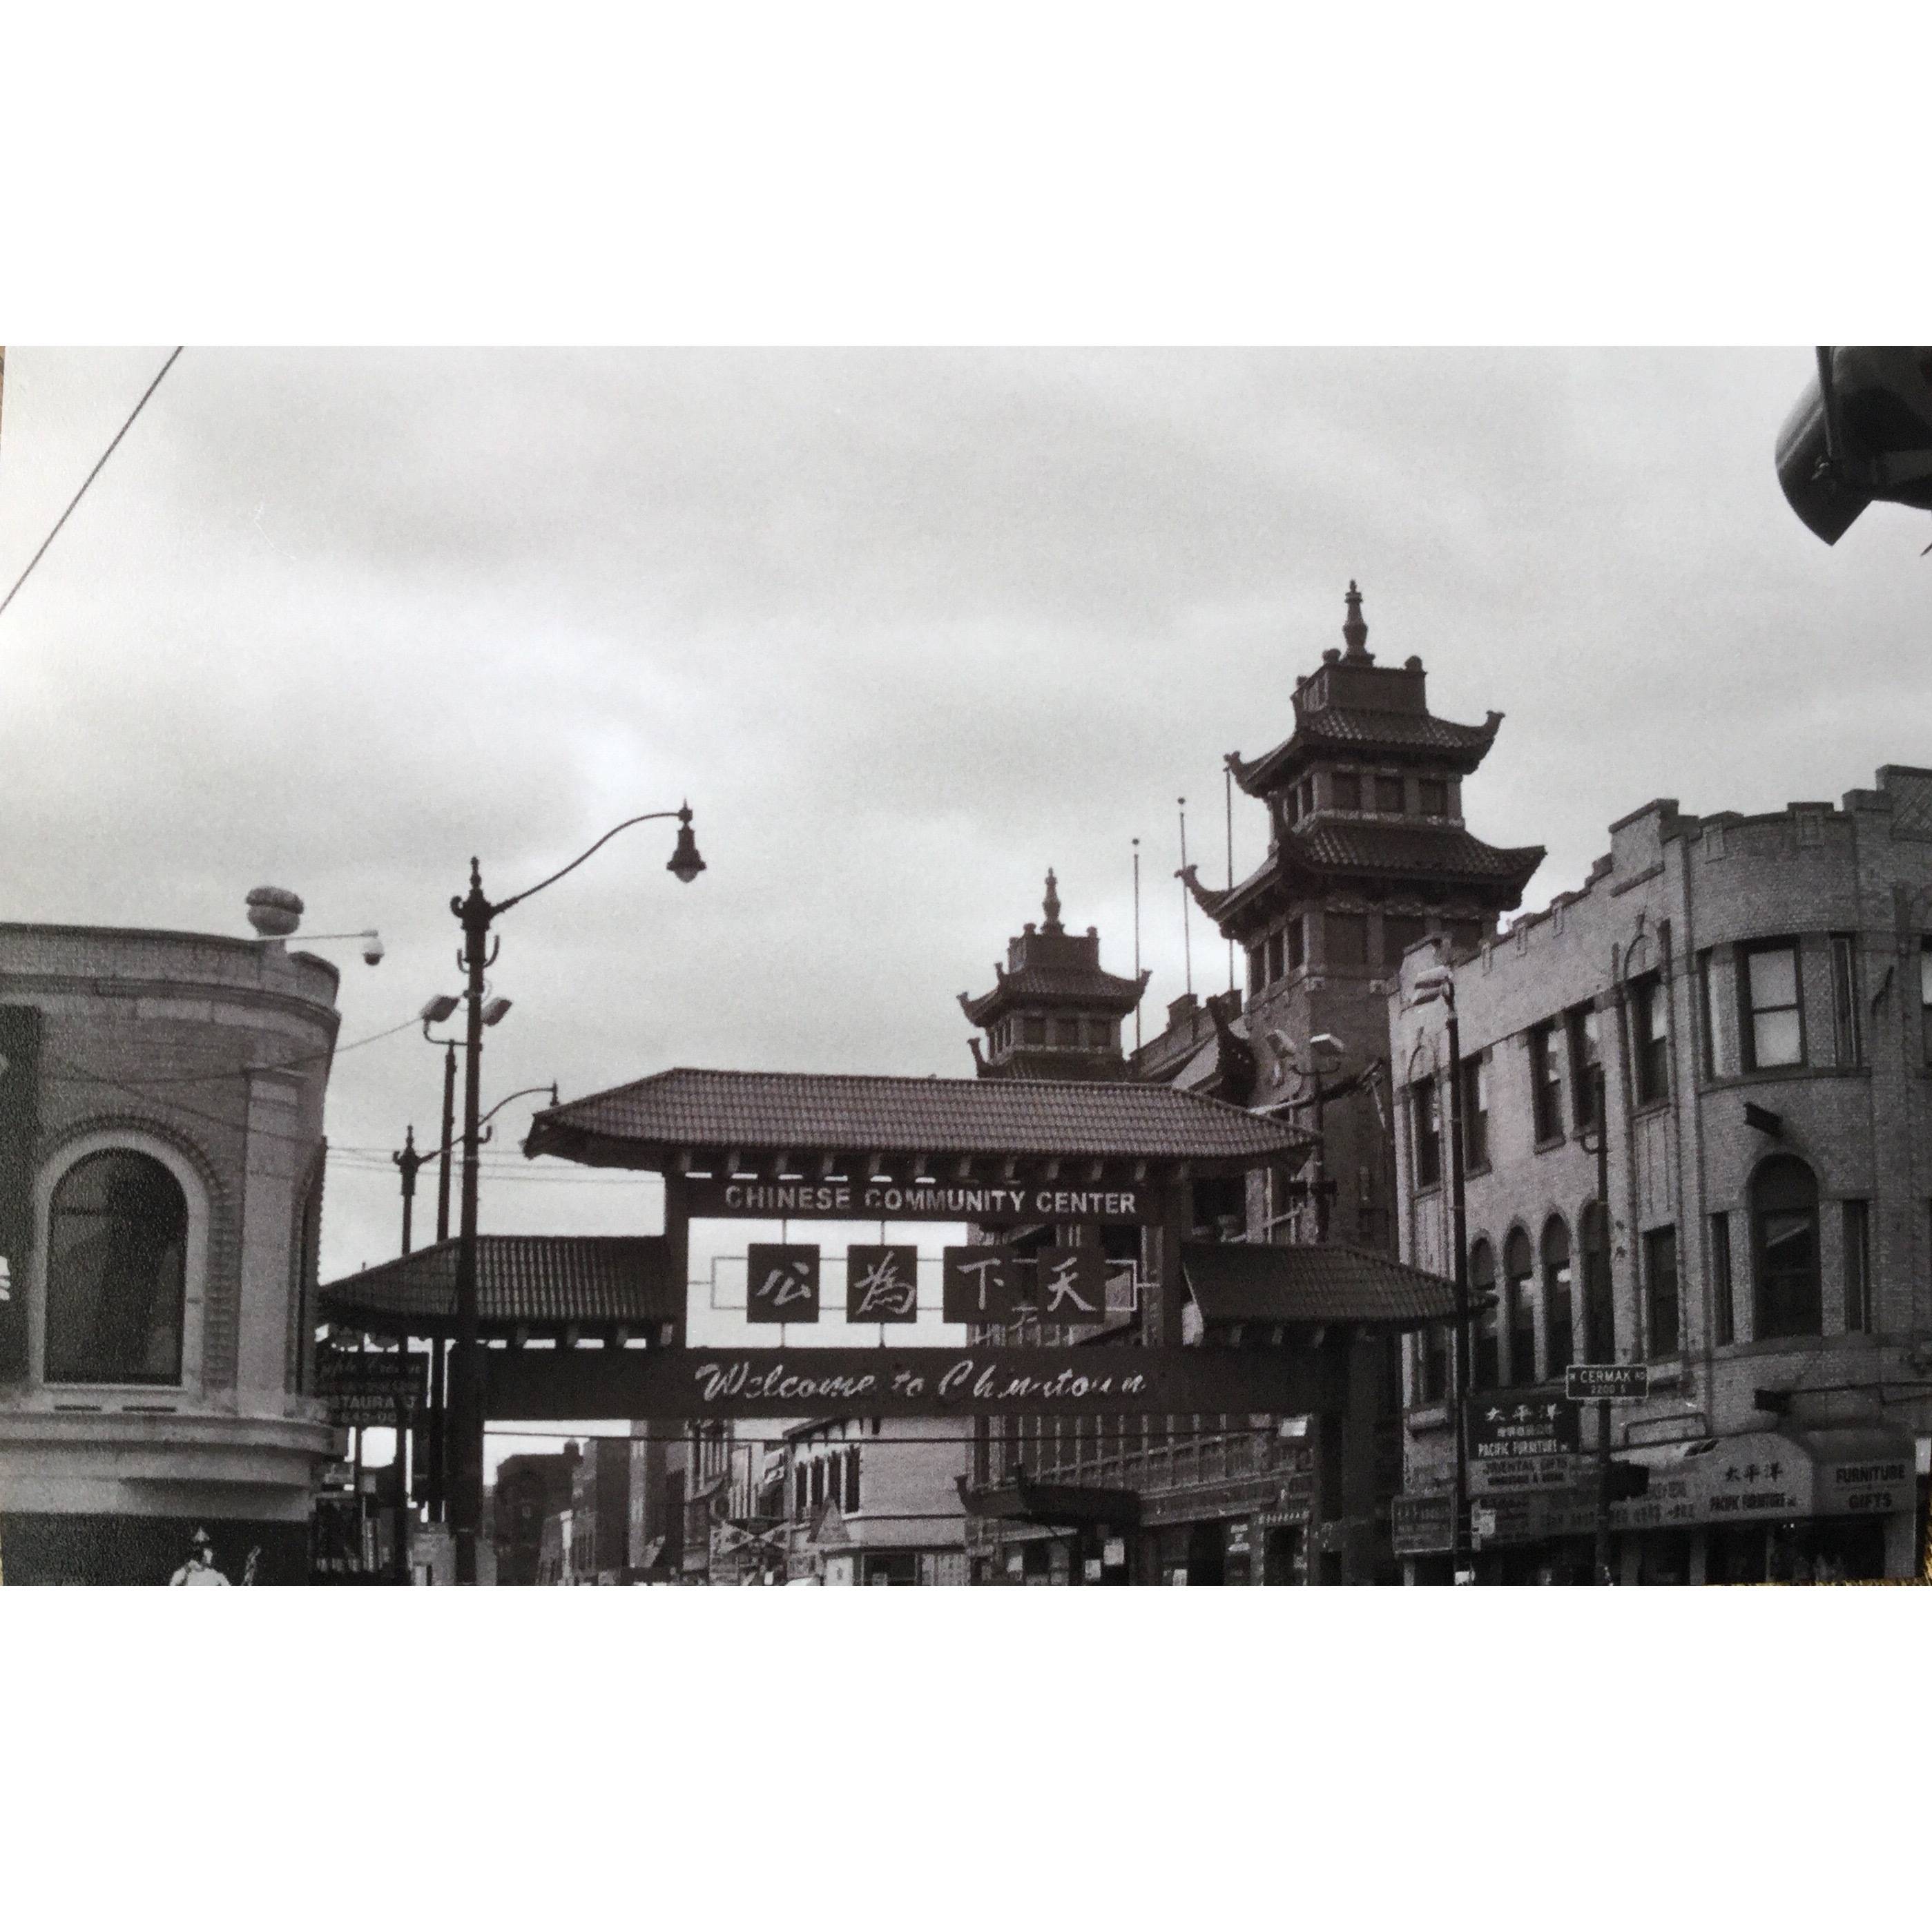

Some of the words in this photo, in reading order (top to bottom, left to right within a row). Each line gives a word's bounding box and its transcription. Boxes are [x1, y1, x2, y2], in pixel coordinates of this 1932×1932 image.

[725, 1186, 851, 1210] CHINESE
[864, 1188, 1026, 1213] COMMUNITY
[1036, 1192, 1135, 1213] CENTER
[695, 1362, 876, 1402] Welcome
[891, 1370, 924, 1398] to
[1580, 1369, 1630, 1384] CERMAK
[1836, 1464, 1905, 1484] FURNITURE
[1848, 1492, 1892, 1509] GIFTS
